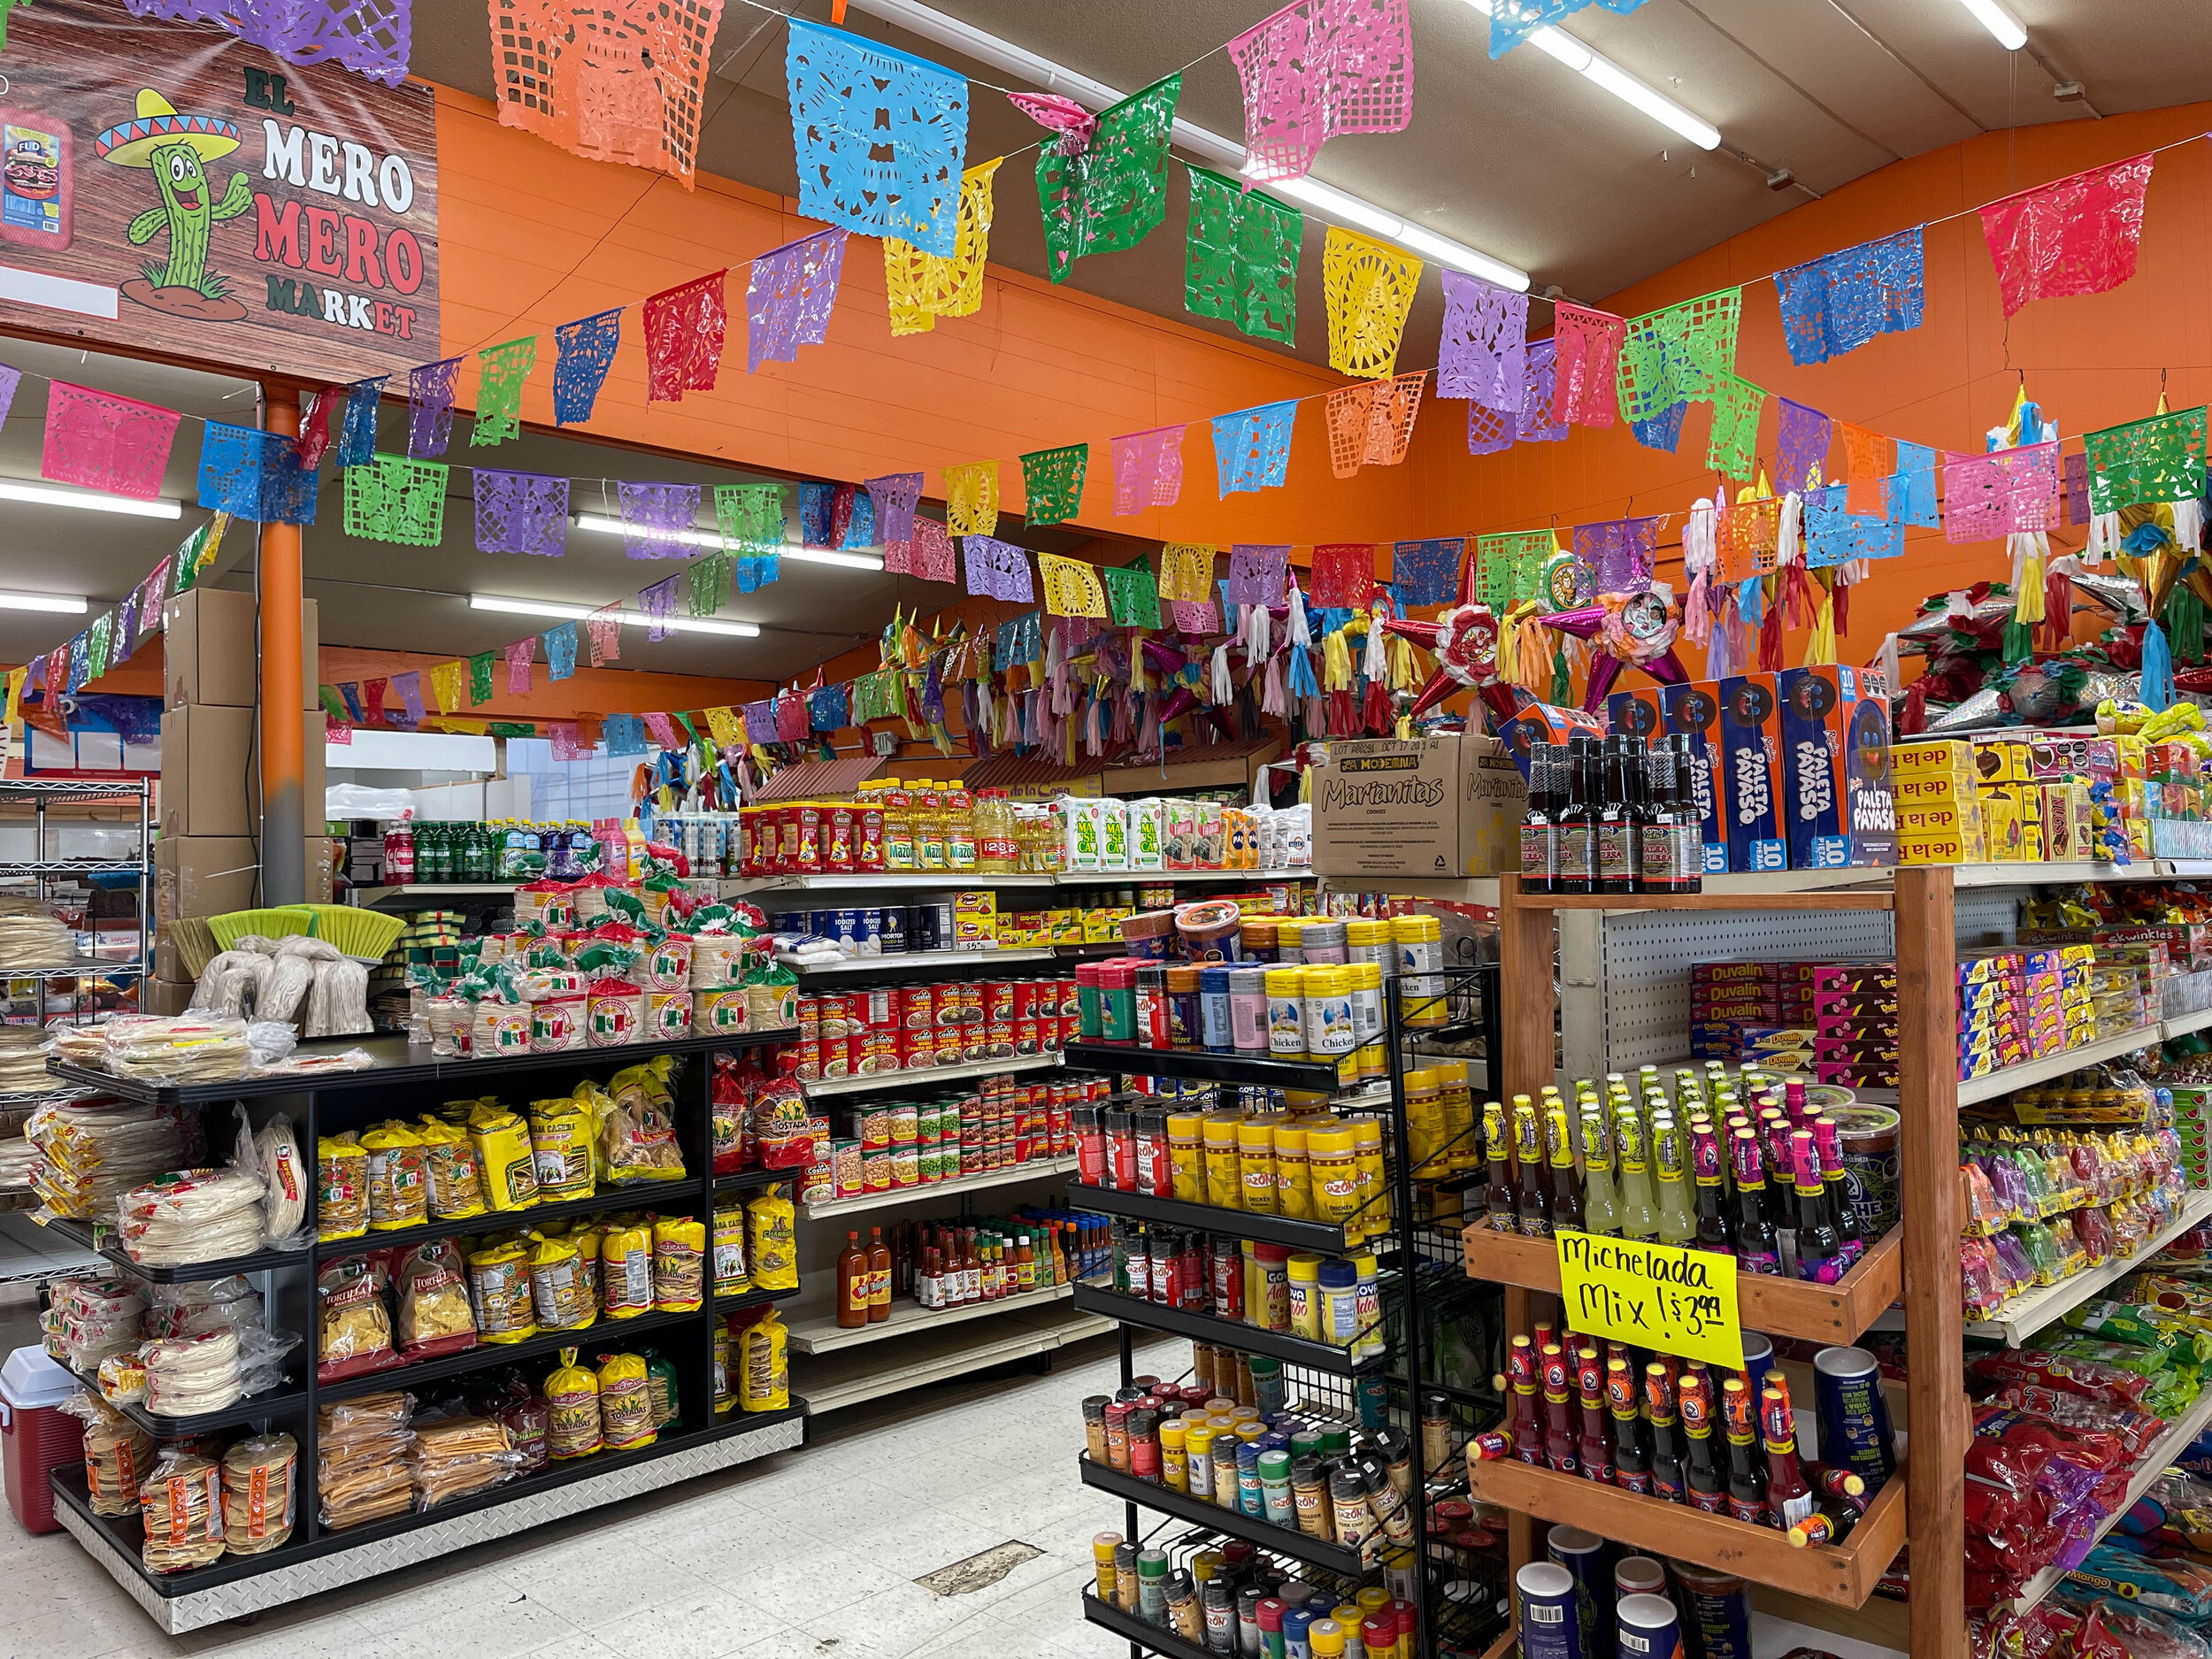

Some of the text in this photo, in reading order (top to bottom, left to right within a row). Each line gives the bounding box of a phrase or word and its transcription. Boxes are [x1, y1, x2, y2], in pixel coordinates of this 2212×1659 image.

[243, 66, 295, 117] EL
[19, 142, 41, 152] FUD
[262, 119, 414, 213] MERO
[253, 192, 424, 295] MERO
[265, 275, 416, 340] MARKET
[1842, 670, 1855, 688] 10
[1334, 745, 1348, 755] LOT
[1382, 742, 1396, 751] OCT
[1400, 741, 1408, 750] 17
[1361, 757, 1417, 770] MODERNA
[1902, 750, 1947, 766] de la
[2058, 757, 2069, 766] 18
[1735, 748, 1756, 825] PAYASO
[1751, 753, 1769, 817] PALETA
[1797, 741, 1817, 821] PAYASO
[1813, 747, 1832, 813] PALETA
[1321, 775, 1445, 812] Marianitas
[1694, 758, 1711, 820] PALETA
[1902, 780, 1947, 797] de la
[1857, 790, 1892, 809] PALETA
[1854, 807, 1895, 831] PAYASO
[1909, 813, 1926, 827] la
[1929, 811, 1953, 826] de
[2051, 795, 2067, 835] NUGS
[889, 844, 911, 858] Mazo
[925, 845, 941, 858] Mazo
[950, 845, 973, 858] Mazol
[1763, 841, 1782, 867] 10
[1825, 839, 1846, 865] 10
[1911, 844, 1931, 858] la
[1932, 842, 1957, 857] de
[1706, 846, 1724, 871] 10
[2031, 932, 2091, 944] skwinkles
[2108, 928, 2174, 944] skwinkles
[1712, 964, 1763, 981] Duvalín
[1710, 984, 1762, 1002] Duvalín
[600, 1000, 627, 1011] BANDERITA
[1710, 1003, 1762, 1021] Duvalín
[1270, 1037, 1302, 1048] Chicken
[1322, 1036, 1355, 1048] Chicken
[1771, 1033, 1803, 1044] Duvalín
[1769, 1054, 1800, 1066] Duvalín
[772, 1120, 809, 1131] TOSTADAS
[764, 1229, 792, 1239] CHARRAS
[1563, 1238, 1713, 1289] Michelada
[1579, 1283, 1650, 1330] Mix
[614, 1378, 644, 1391] MEXICANO
[560, 1391, 591, 1403] MEXICANO
[611, 1406, 647, 1419] TOSTADAS
[556, 1419, 591, 1431] TOSTADAS
[515, 1430, 545, 1441] CHARRAS
[2070, 1570, 2111, 1588] Mango
